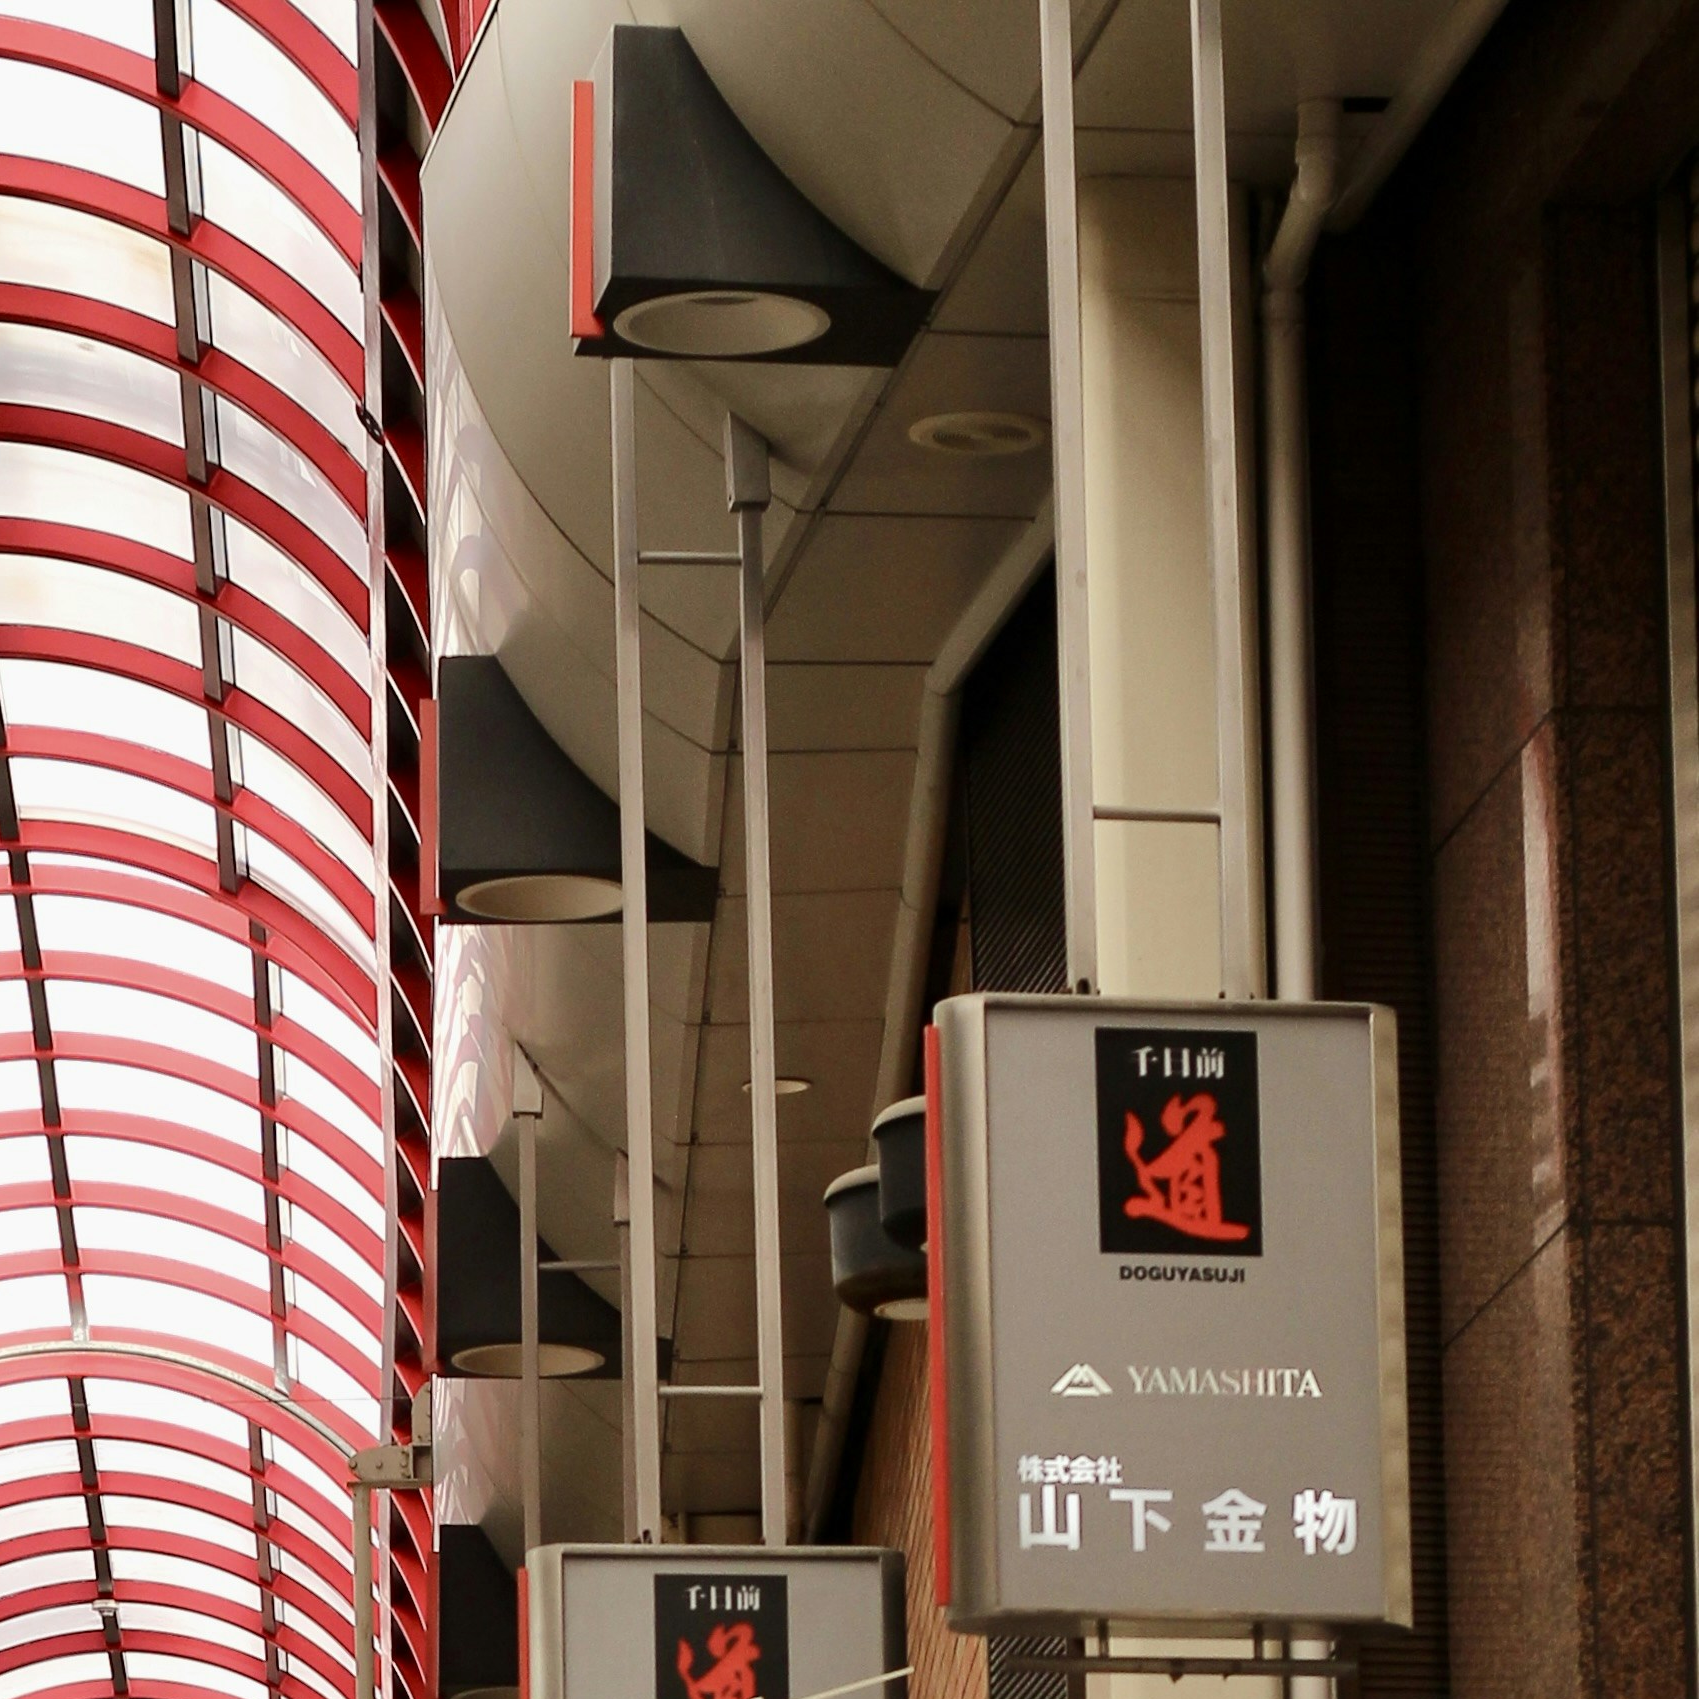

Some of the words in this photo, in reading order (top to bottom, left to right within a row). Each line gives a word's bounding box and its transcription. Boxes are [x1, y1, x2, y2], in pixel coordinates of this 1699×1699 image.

[1132, 1046, 1225, 1080] 千日前
[1119, 1264, 1247, 1283] DOGUYASUJI
[1127, 1364, 1323, 1399] YAMASHITA
[1018, 1455, 1124, 1484] 株式会社
[1018, 1485, 1358, 1556] 山下金物
[684, 1585, 761, 1612] 千日前
